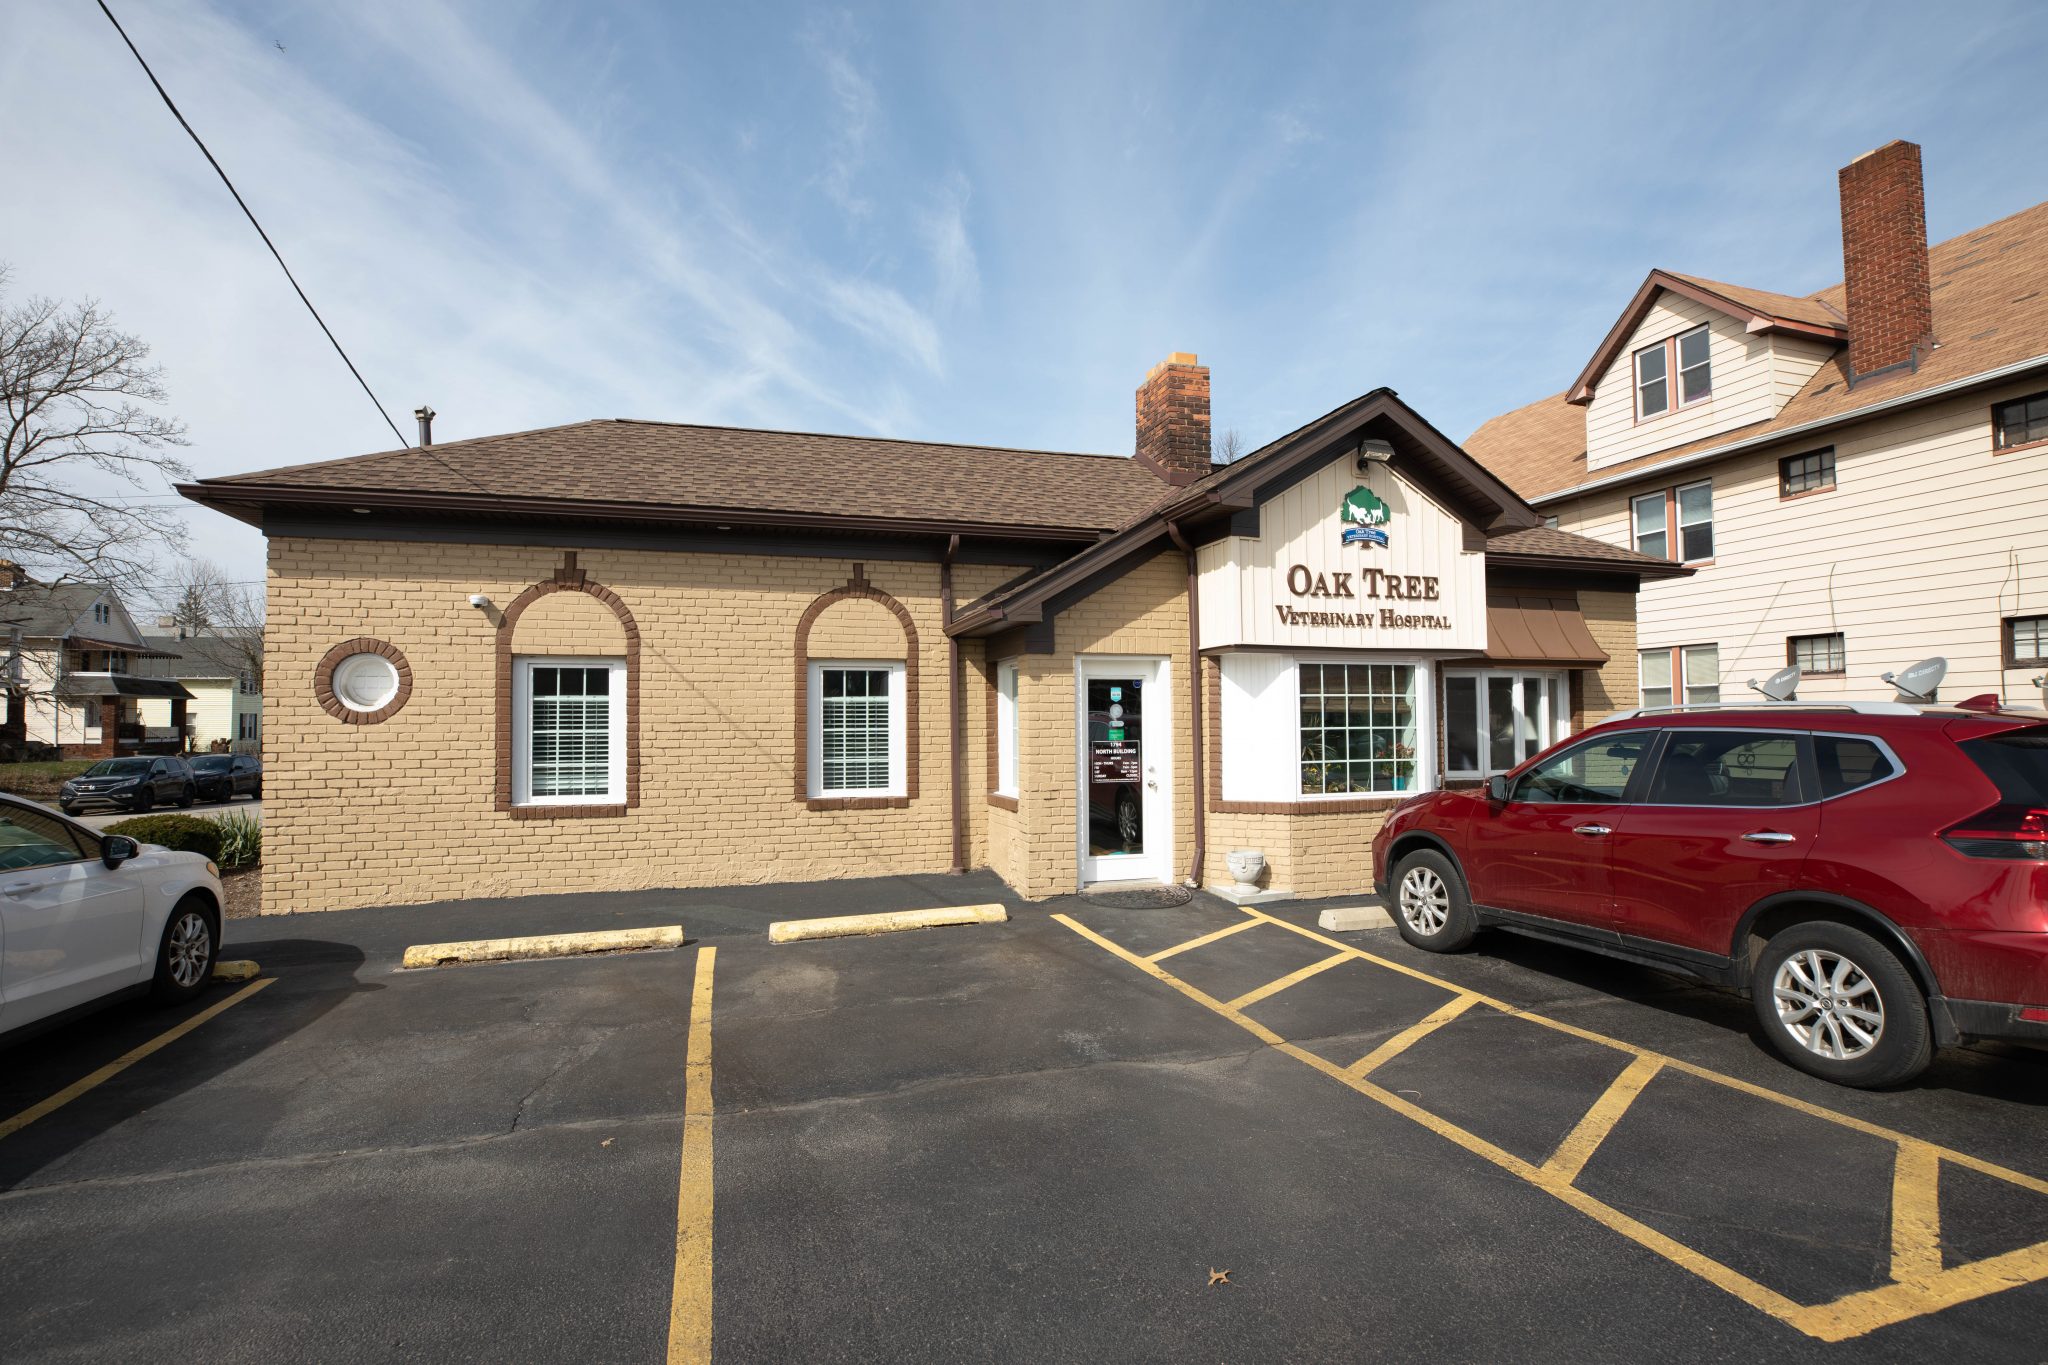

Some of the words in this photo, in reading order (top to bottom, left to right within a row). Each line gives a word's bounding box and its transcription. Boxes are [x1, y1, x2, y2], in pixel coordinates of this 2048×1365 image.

[1287, 564, 1354, 598] OAK
[1363, 568, 1440, 601] TREE
[1275, 605, 1374, 627] VETERINARY
[1379, 608, 1452, 629] HOSPITAL
